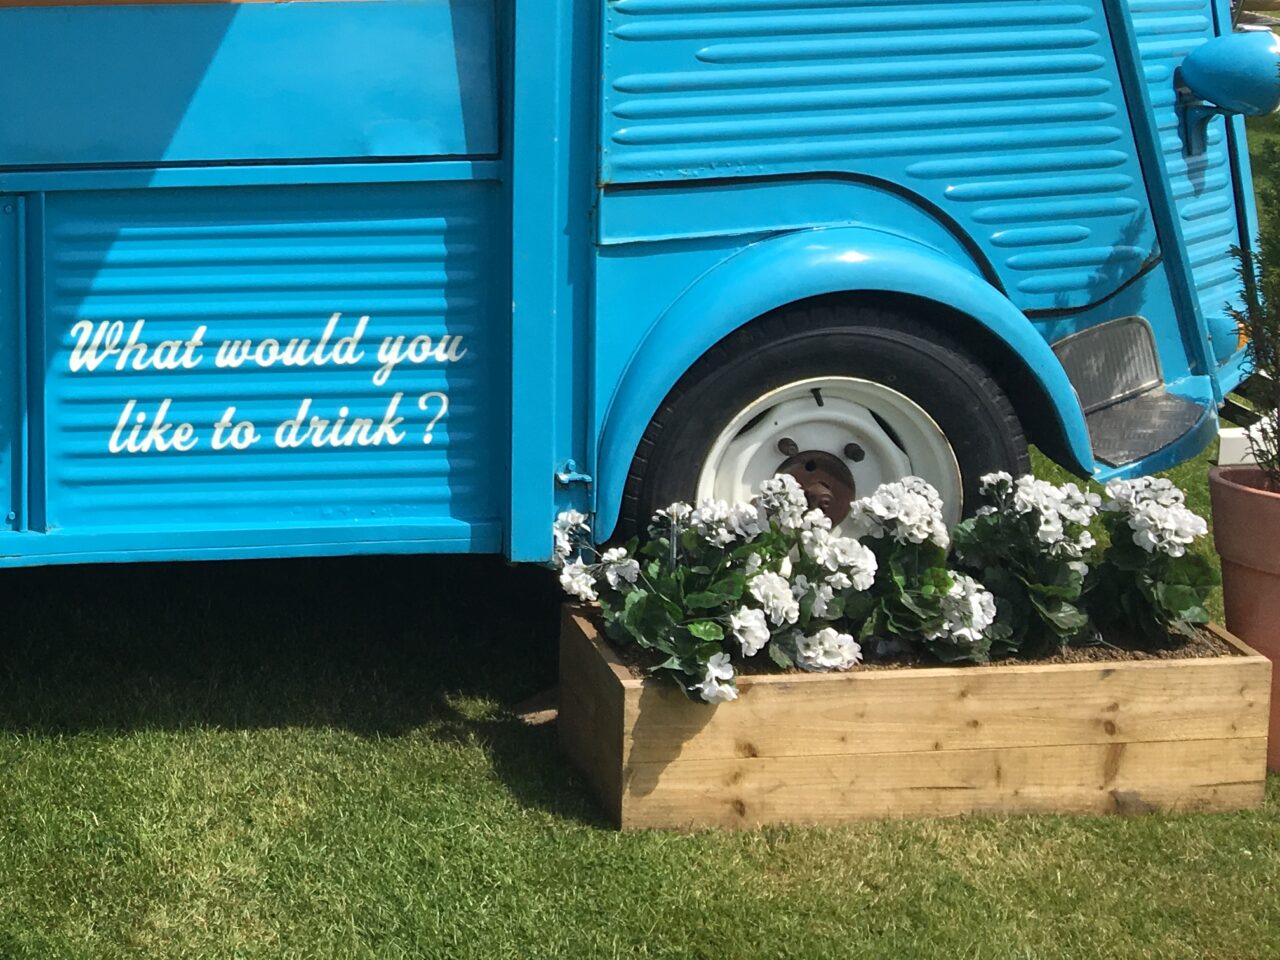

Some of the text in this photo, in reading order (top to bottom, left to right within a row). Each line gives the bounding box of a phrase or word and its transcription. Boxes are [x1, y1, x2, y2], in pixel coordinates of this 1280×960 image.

[69, 312, 468, 387] What would you
[108, 398, 200, 454] like
[210, 406, 261, 450] to
